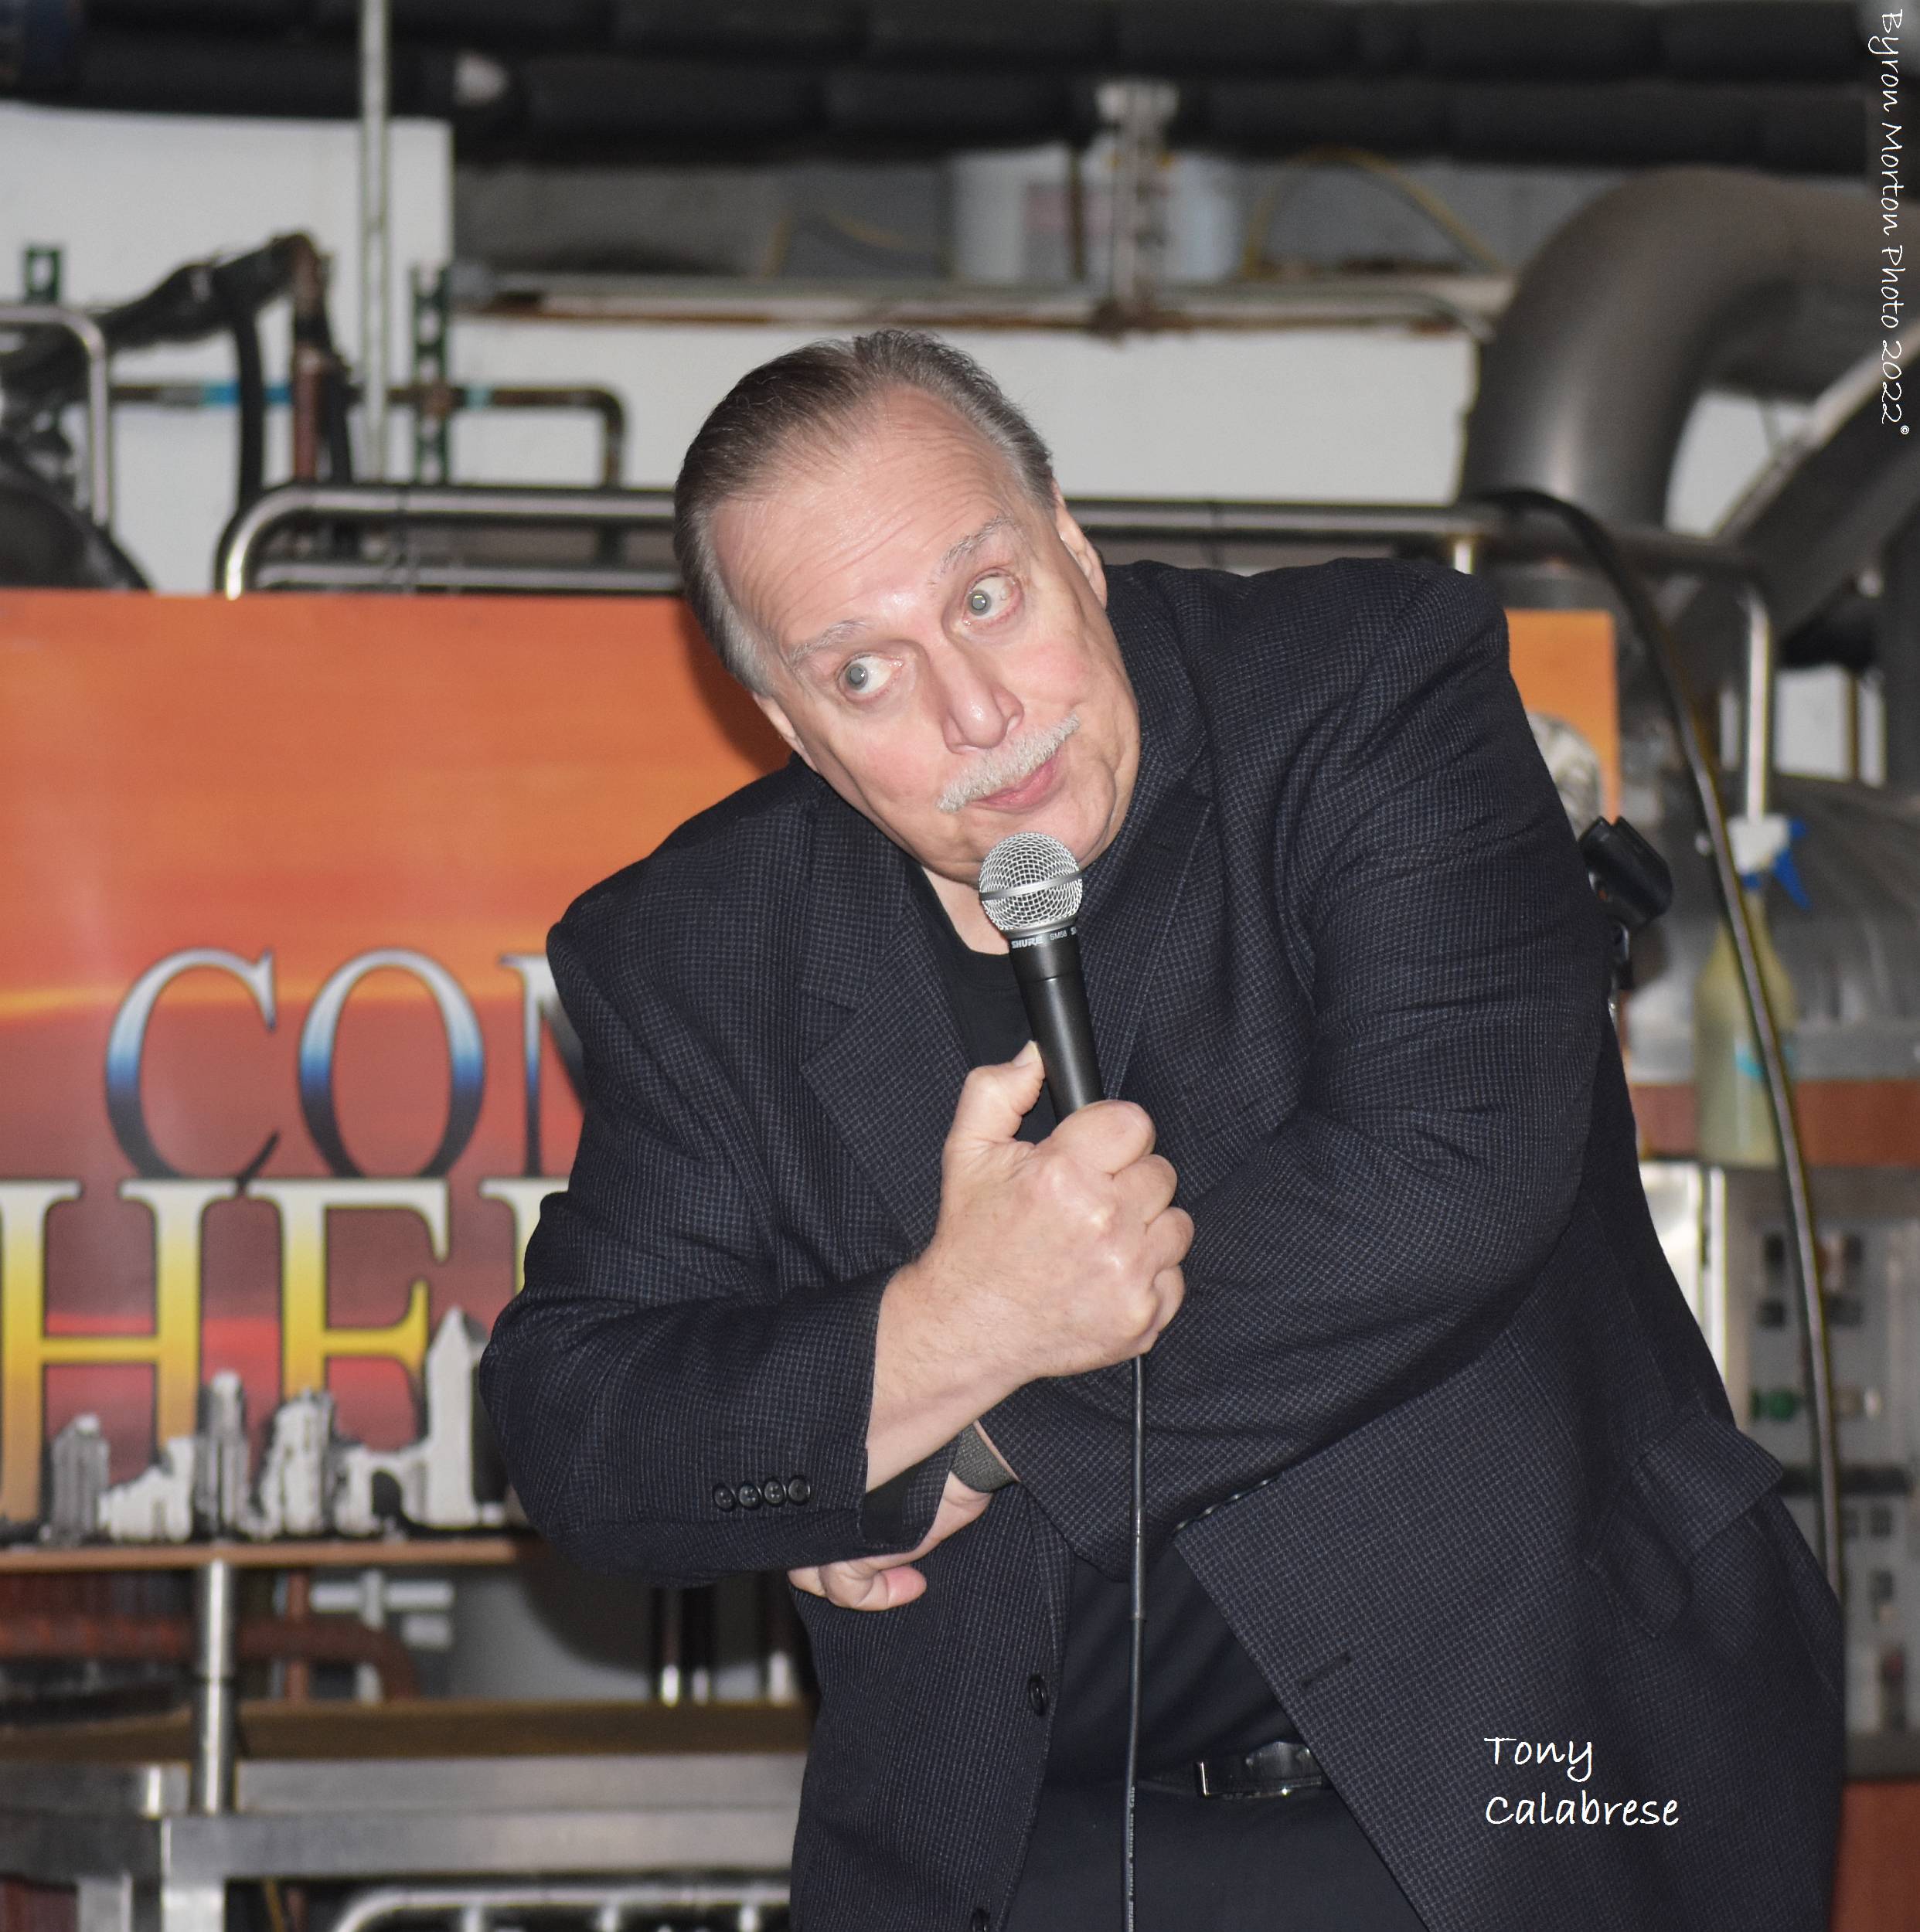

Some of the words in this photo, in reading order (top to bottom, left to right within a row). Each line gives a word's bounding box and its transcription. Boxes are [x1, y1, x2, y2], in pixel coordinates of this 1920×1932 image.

[1011, 936, 1044, 949] SHURE
[1050, 930, 1067, 940] SM58
[0, 1178, 570, 1522] HE
